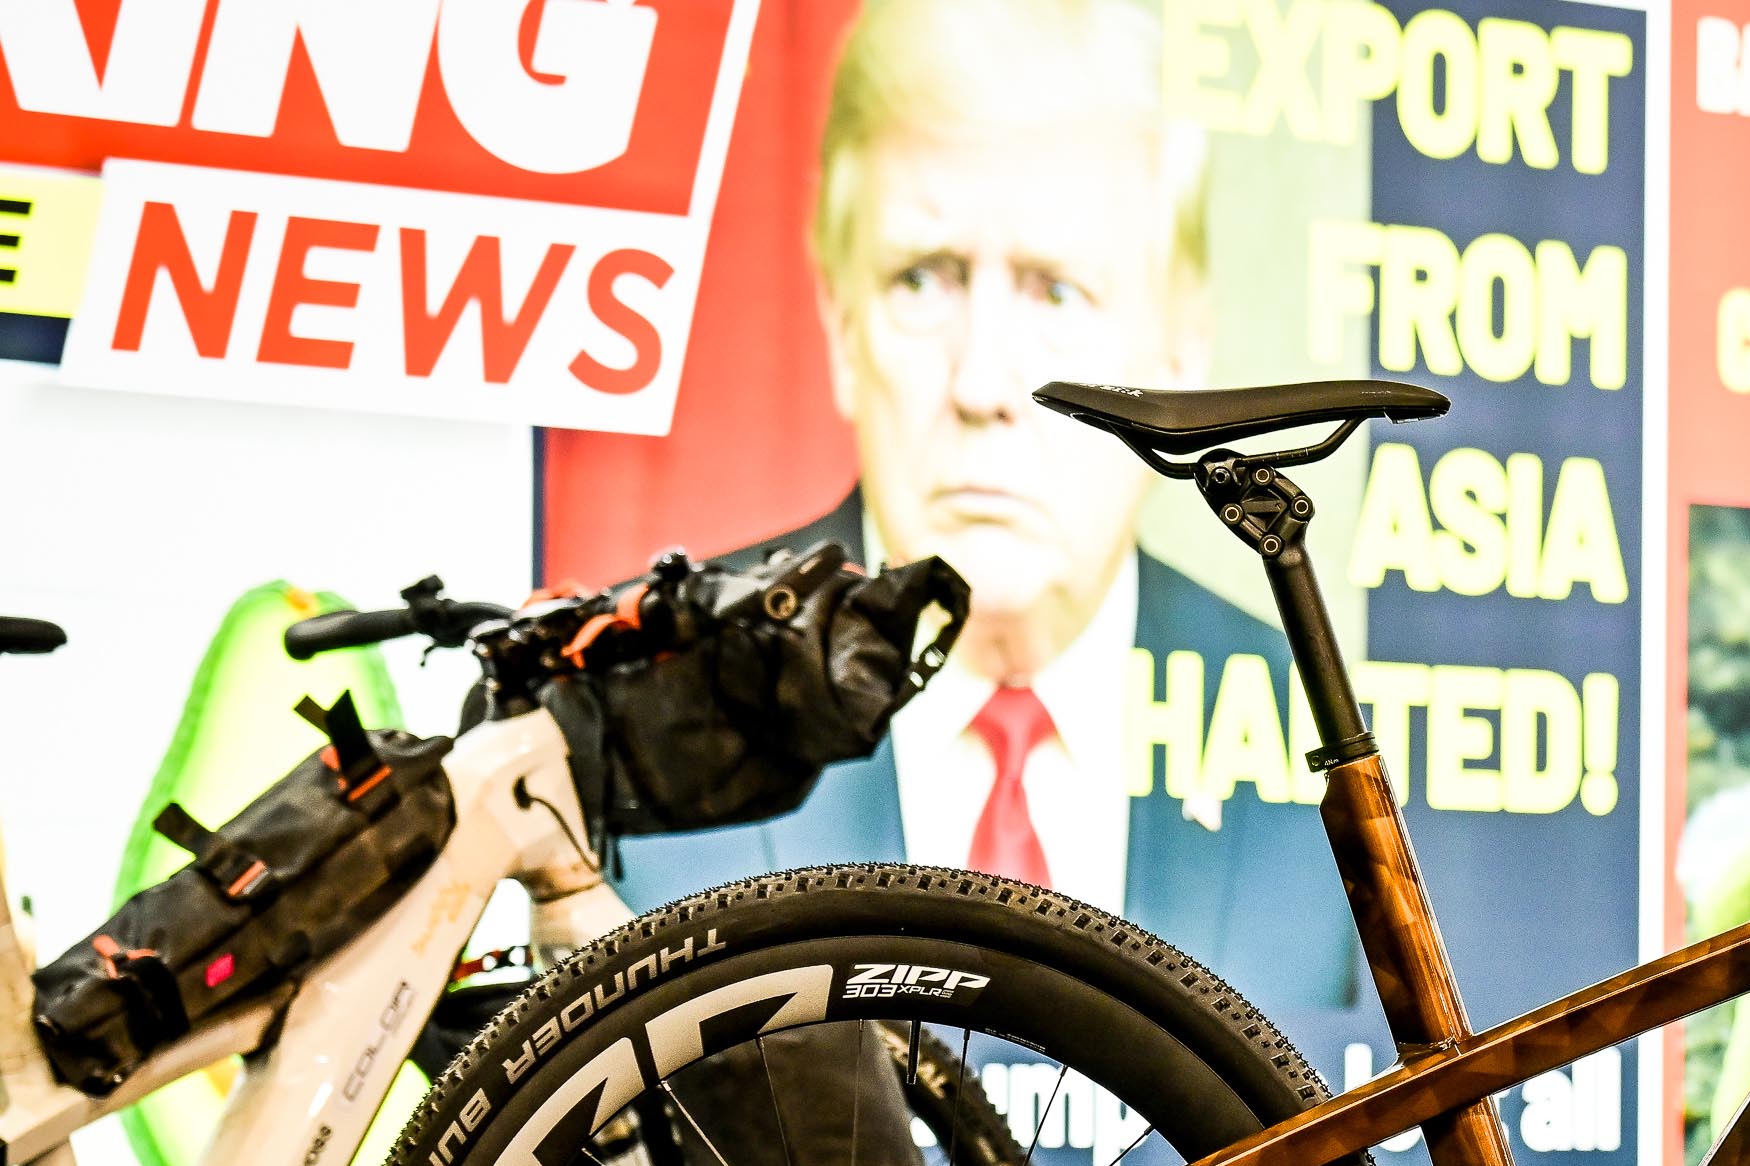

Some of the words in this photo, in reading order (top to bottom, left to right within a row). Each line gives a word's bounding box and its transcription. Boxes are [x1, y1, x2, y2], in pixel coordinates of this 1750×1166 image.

[1165, 0, 1634, 175] EXPORT
[111, 202, 675, 394] NEWS
[1306, 218, 1627, 390] FROM
[1348, 443, 1628, 603] ASIA
[505, 927, 727, 1084] THUNDER
[842, 984, 896, 999] 303
[847, 963, 990, 990] ZIPP
